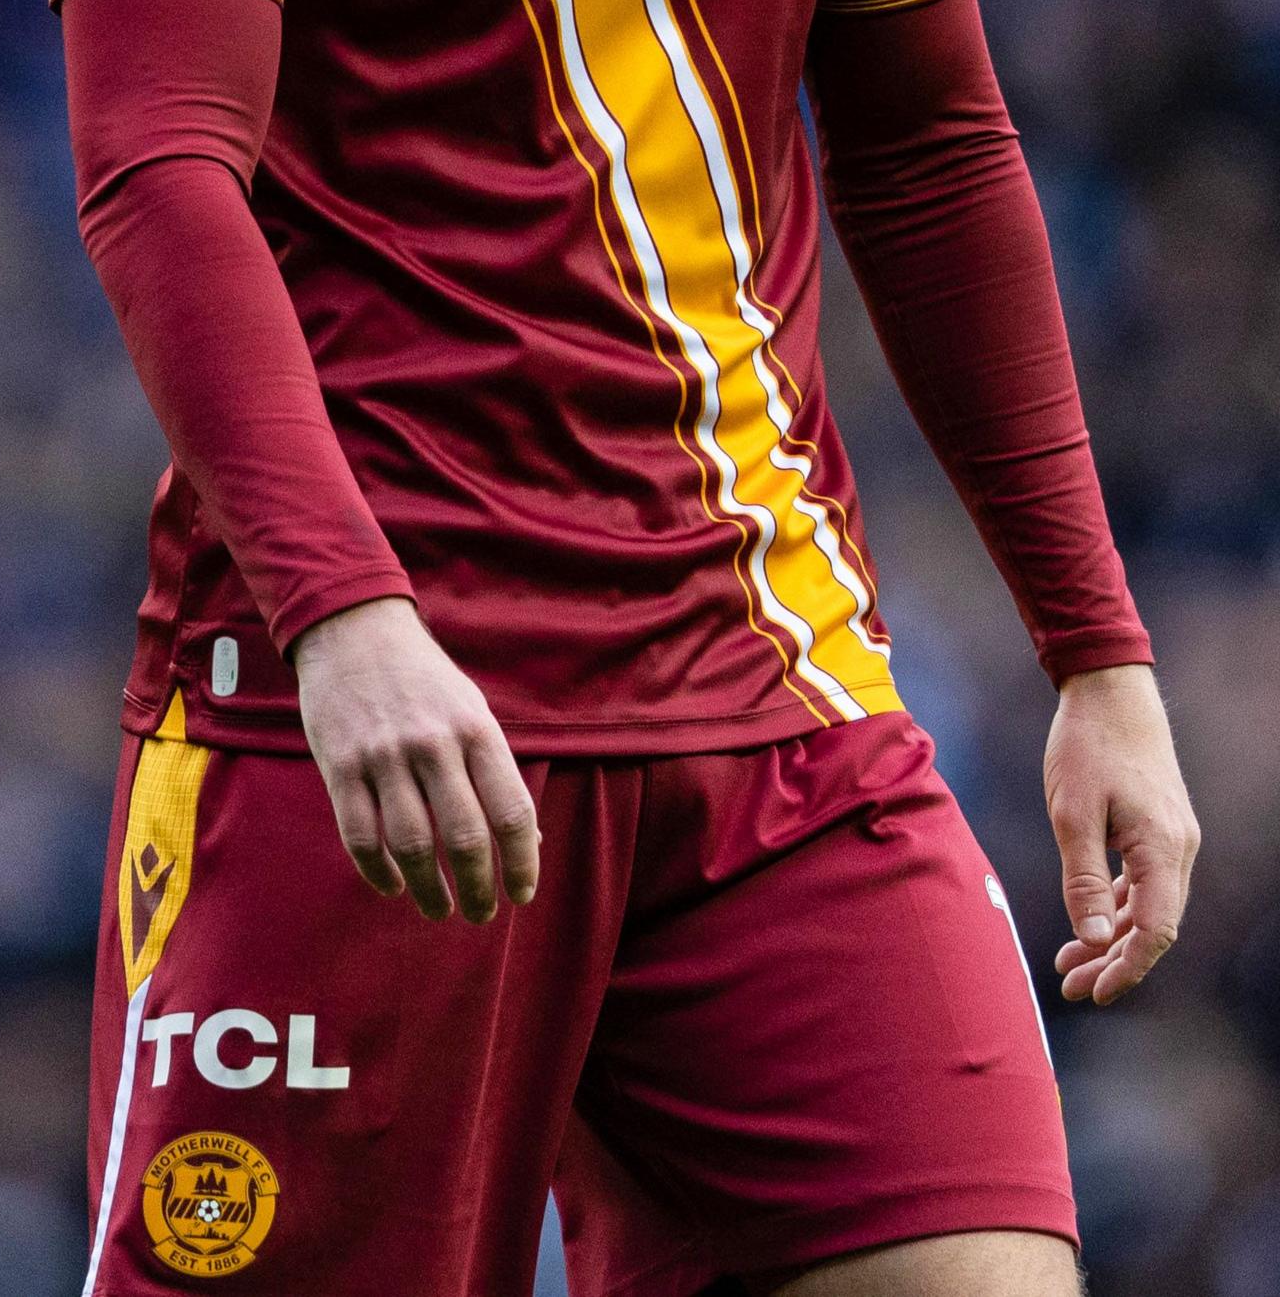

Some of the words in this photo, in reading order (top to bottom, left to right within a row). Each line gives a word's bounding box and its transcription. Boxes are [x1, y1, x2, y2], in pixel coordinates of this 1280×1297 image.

[141, 1008, 351, 1090] TCL
[151, 1136, 250, 1179] MOTHERWELL
[206, 1254, 240, 1272] 1886
